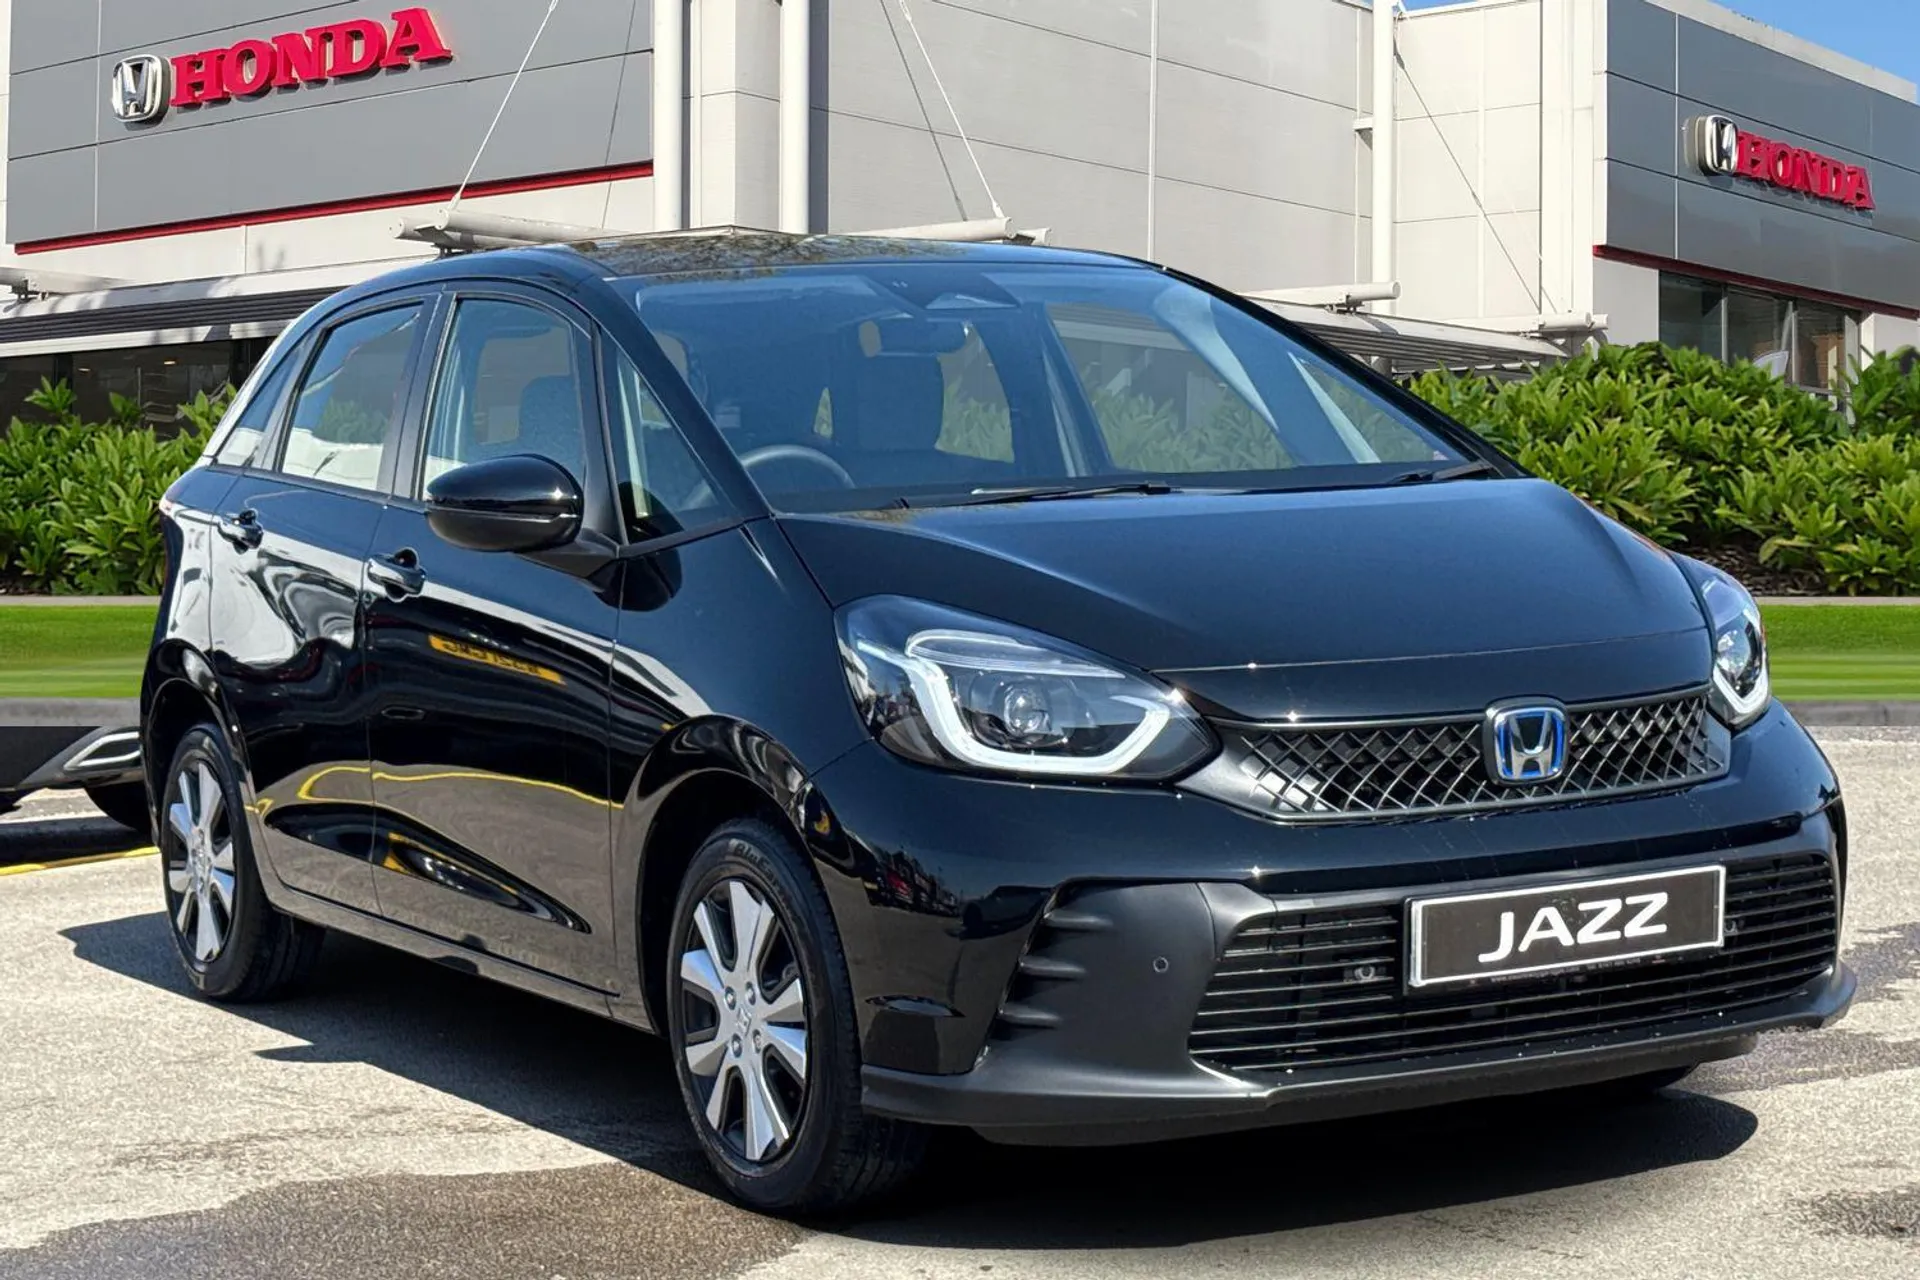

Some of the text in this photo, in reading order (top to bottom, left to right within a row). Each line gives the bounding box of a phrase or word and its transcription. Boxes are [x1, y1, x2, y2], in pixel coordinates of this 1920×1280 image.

[170, 7, 453, 108] HONDA
[1735, 130, 1875, 210] HONDA
[1477, 891, 1669, 964] JAZZ
